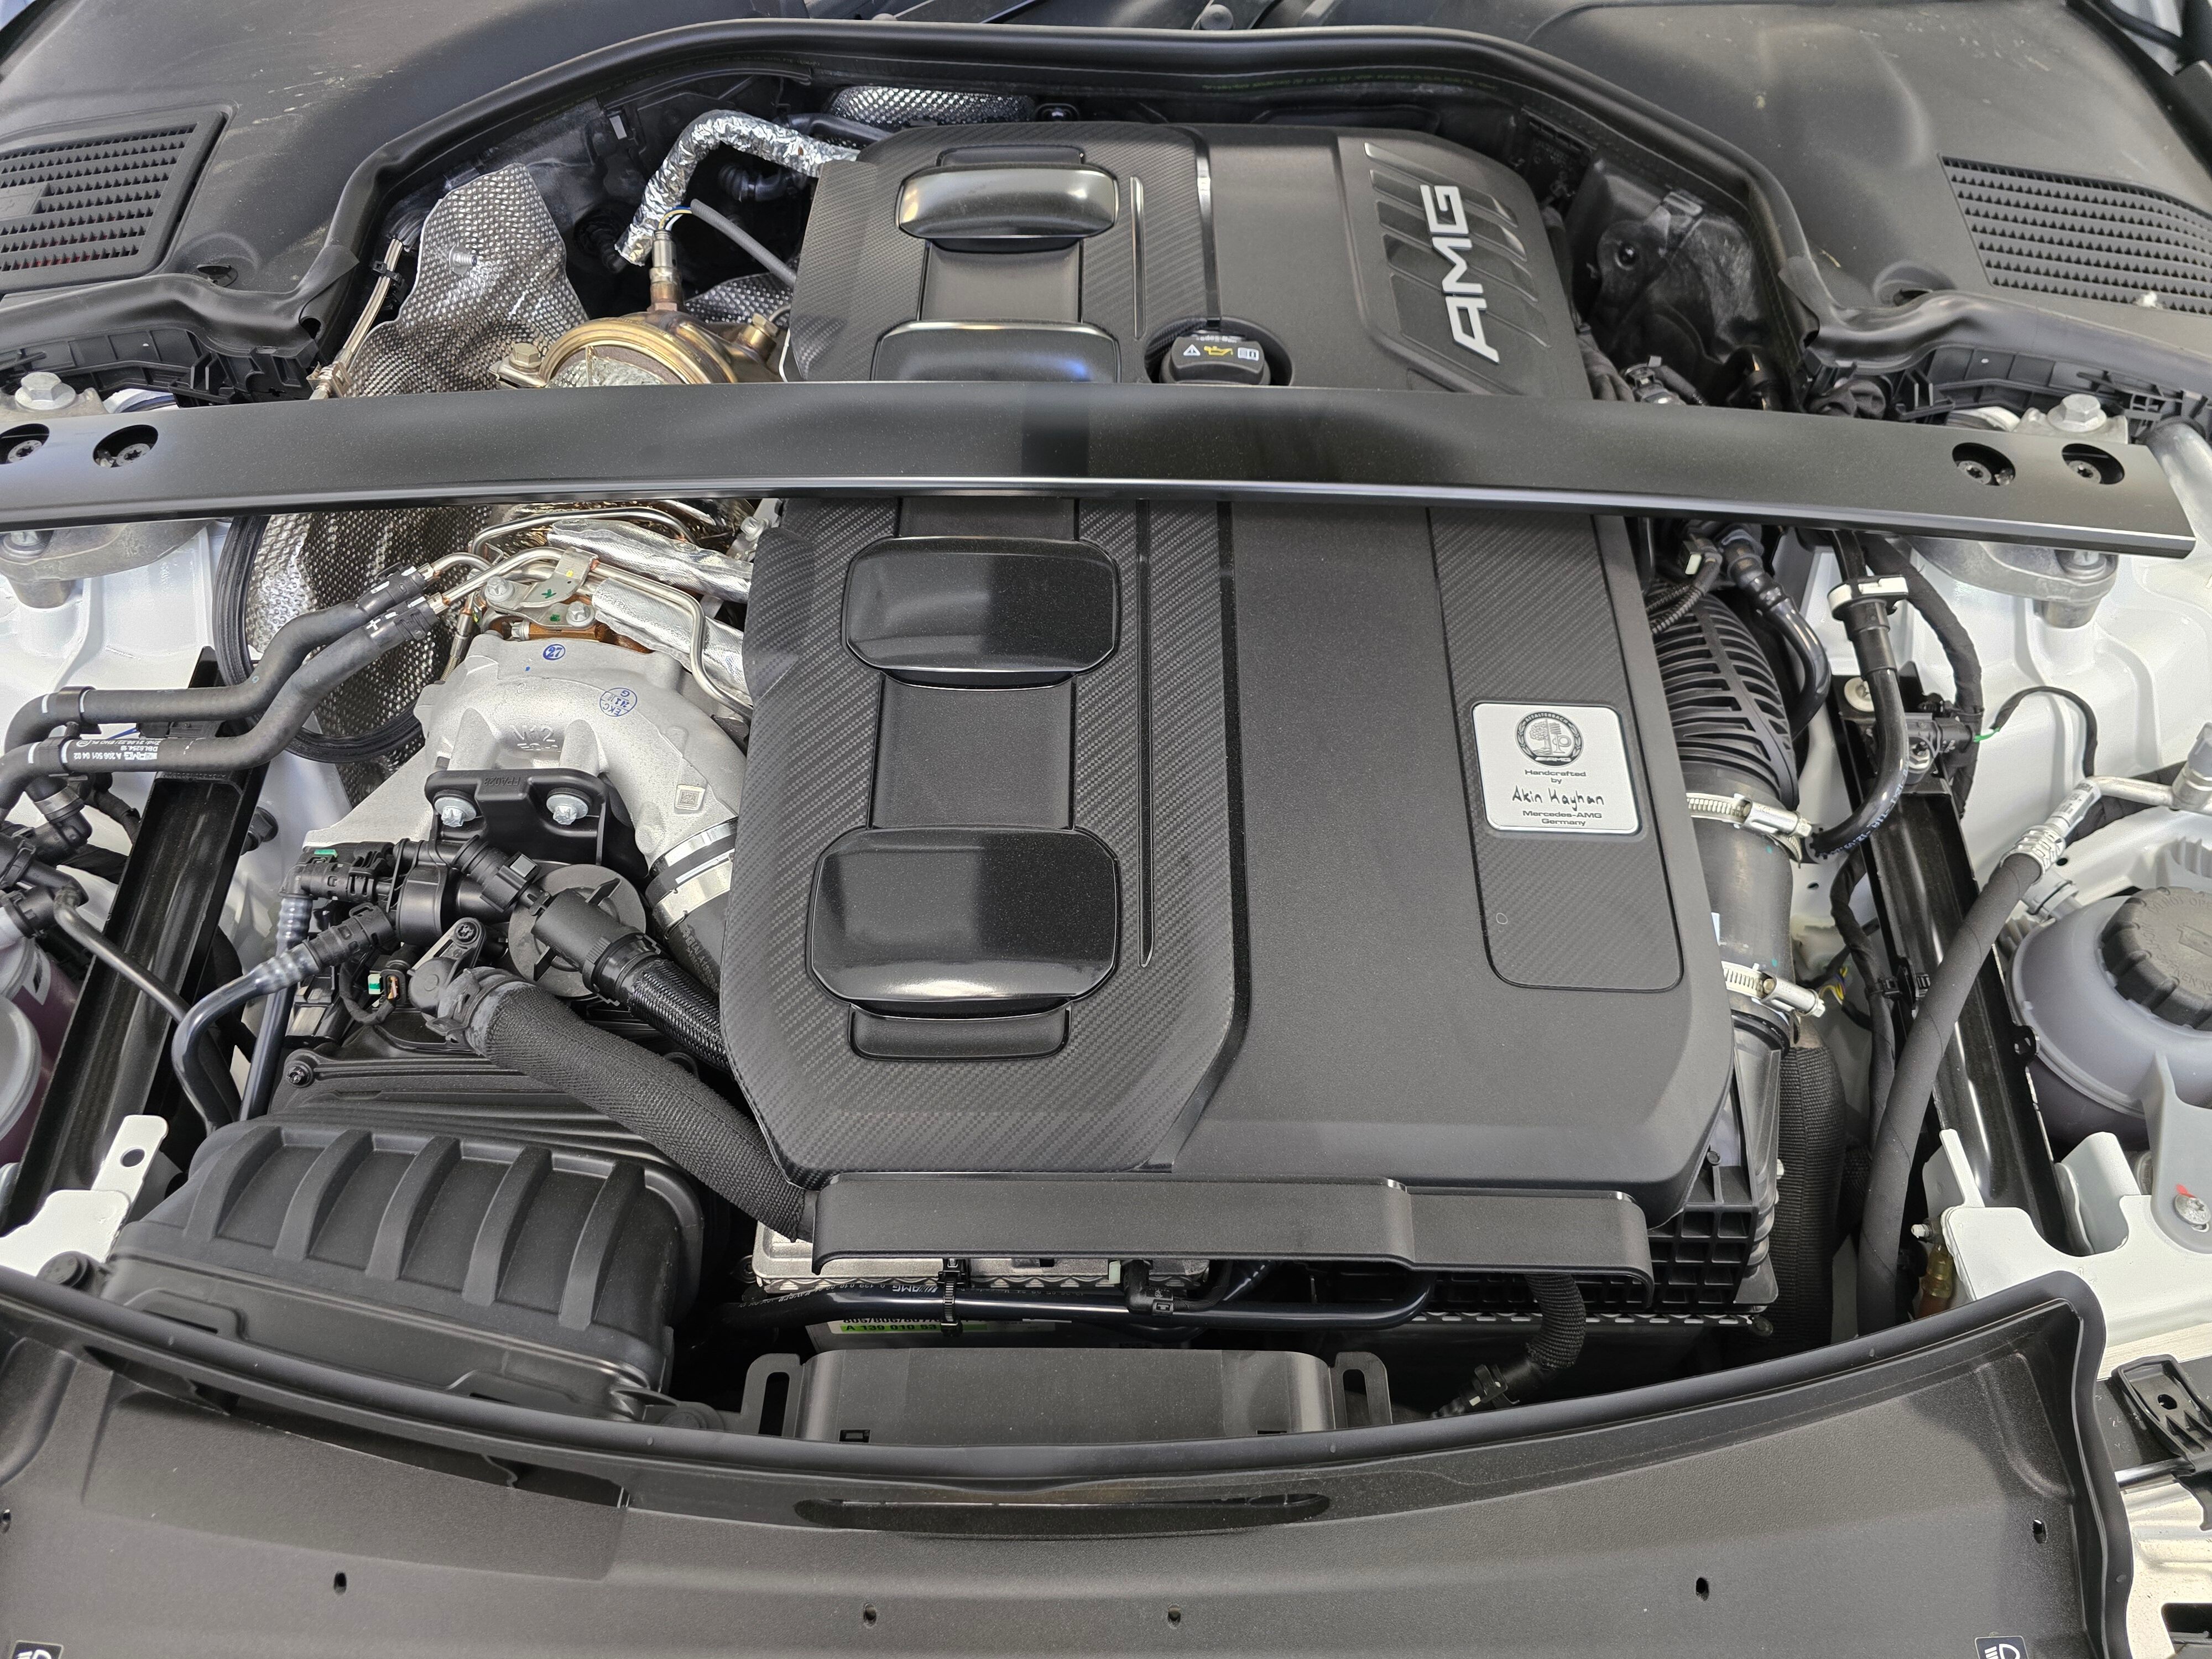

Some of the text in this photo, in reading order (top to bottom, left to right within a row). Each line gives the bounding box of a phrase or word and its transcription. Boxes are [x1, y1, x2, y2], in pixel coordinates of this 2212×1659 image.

[1420, 184, 1500, 364] AMG
[547, 646, 562, 658] 27
[603, 703, 622, 716] EKC
[1512, 785, 1543, 804] Akin
[1522, 810, 1603, 818] Mercedes-AMG
[1541, 818, 1586, 827] Germany
